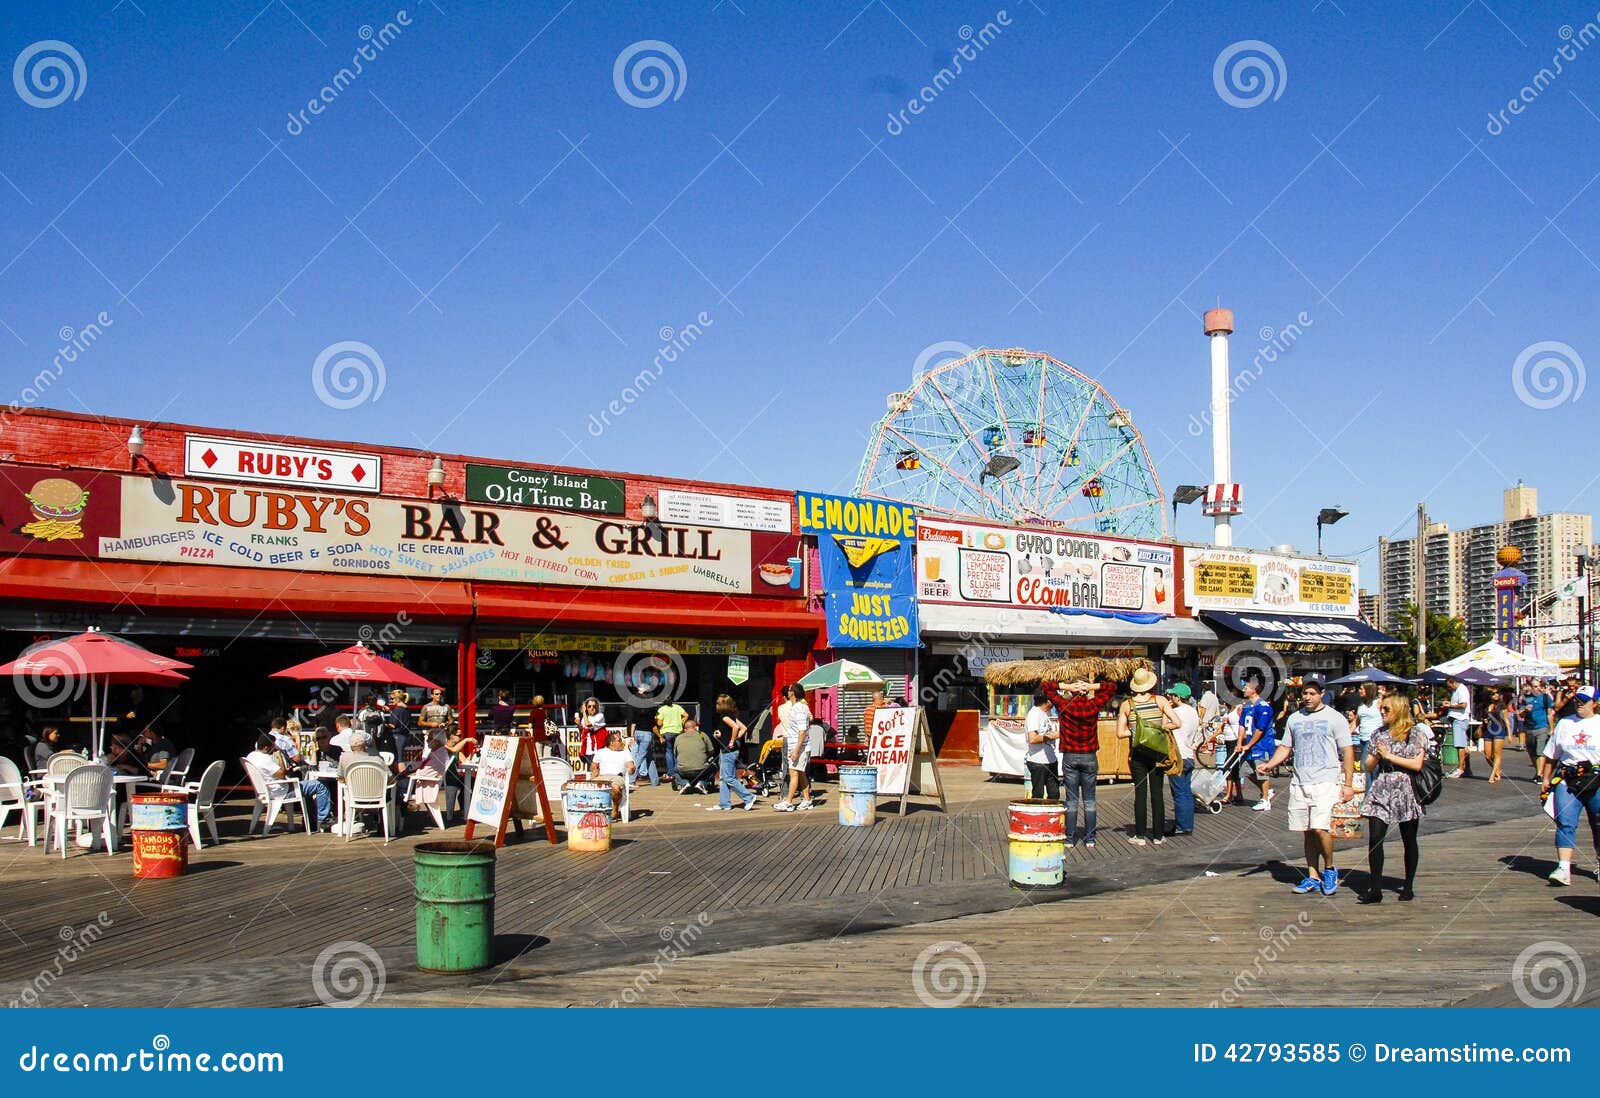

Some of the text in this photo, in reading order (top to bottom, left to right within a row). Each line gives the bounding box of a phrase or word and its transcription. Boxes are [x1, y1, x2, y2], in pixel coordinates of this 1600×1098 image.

[238, 450, 333, 481] RUBY'S
[507, 470, 588, 490] Coney Island
[485, 484, 608, 511] Old Time Bar
[176, 483, 722, 561] RUBY'S BAR & GRILL
[798, 495, 916, 538] LEMONADE
[250, 533, 298, 547] FRANKS
[1016, 533, 1100, 560] GYRO CORNER
[104, 530, 599, 582] HAMBURGERS ICE COLD BEER & SODA HOT SWEET SAUSAGES HOT BUTTERED CORN
[179, 546, 215, 559] PIZZA
[397, 543, 464, 556] ICE CREAM
[332, 558, 390, 570] CORNDOGS
[568, 556, 631, 569] GOLDEN FRIED
[1228, 554, 1252, 563] DOGS
[608, 571, 646, 584] CHICKEN
[659, 564, 689, 577] SHRIMP
[966, 562, 1005, 573] LEMONADE
[693, 565, 740, 590] UMBRELLAS
[967, 571, 1000, 581] PRETZELS
[924, 588, 949, 597] BEER
[970, 580, 1001, 590] SLUSHIE
[1017, 577, 1099, 608] Clam BAR
[972, 589, 993, 598] PIZZA
[851, 592, 892, 617] JUST
[1321, 604, 1346, 612] CREAM
[839, 613, 909, 642] SQUEEZED
[651, 639, 688, 651] CREAM
[877, 710, 905, 735] Soft
[871, 735, 906, 749] ICE
[868, 750, 909, 766] CREAM
